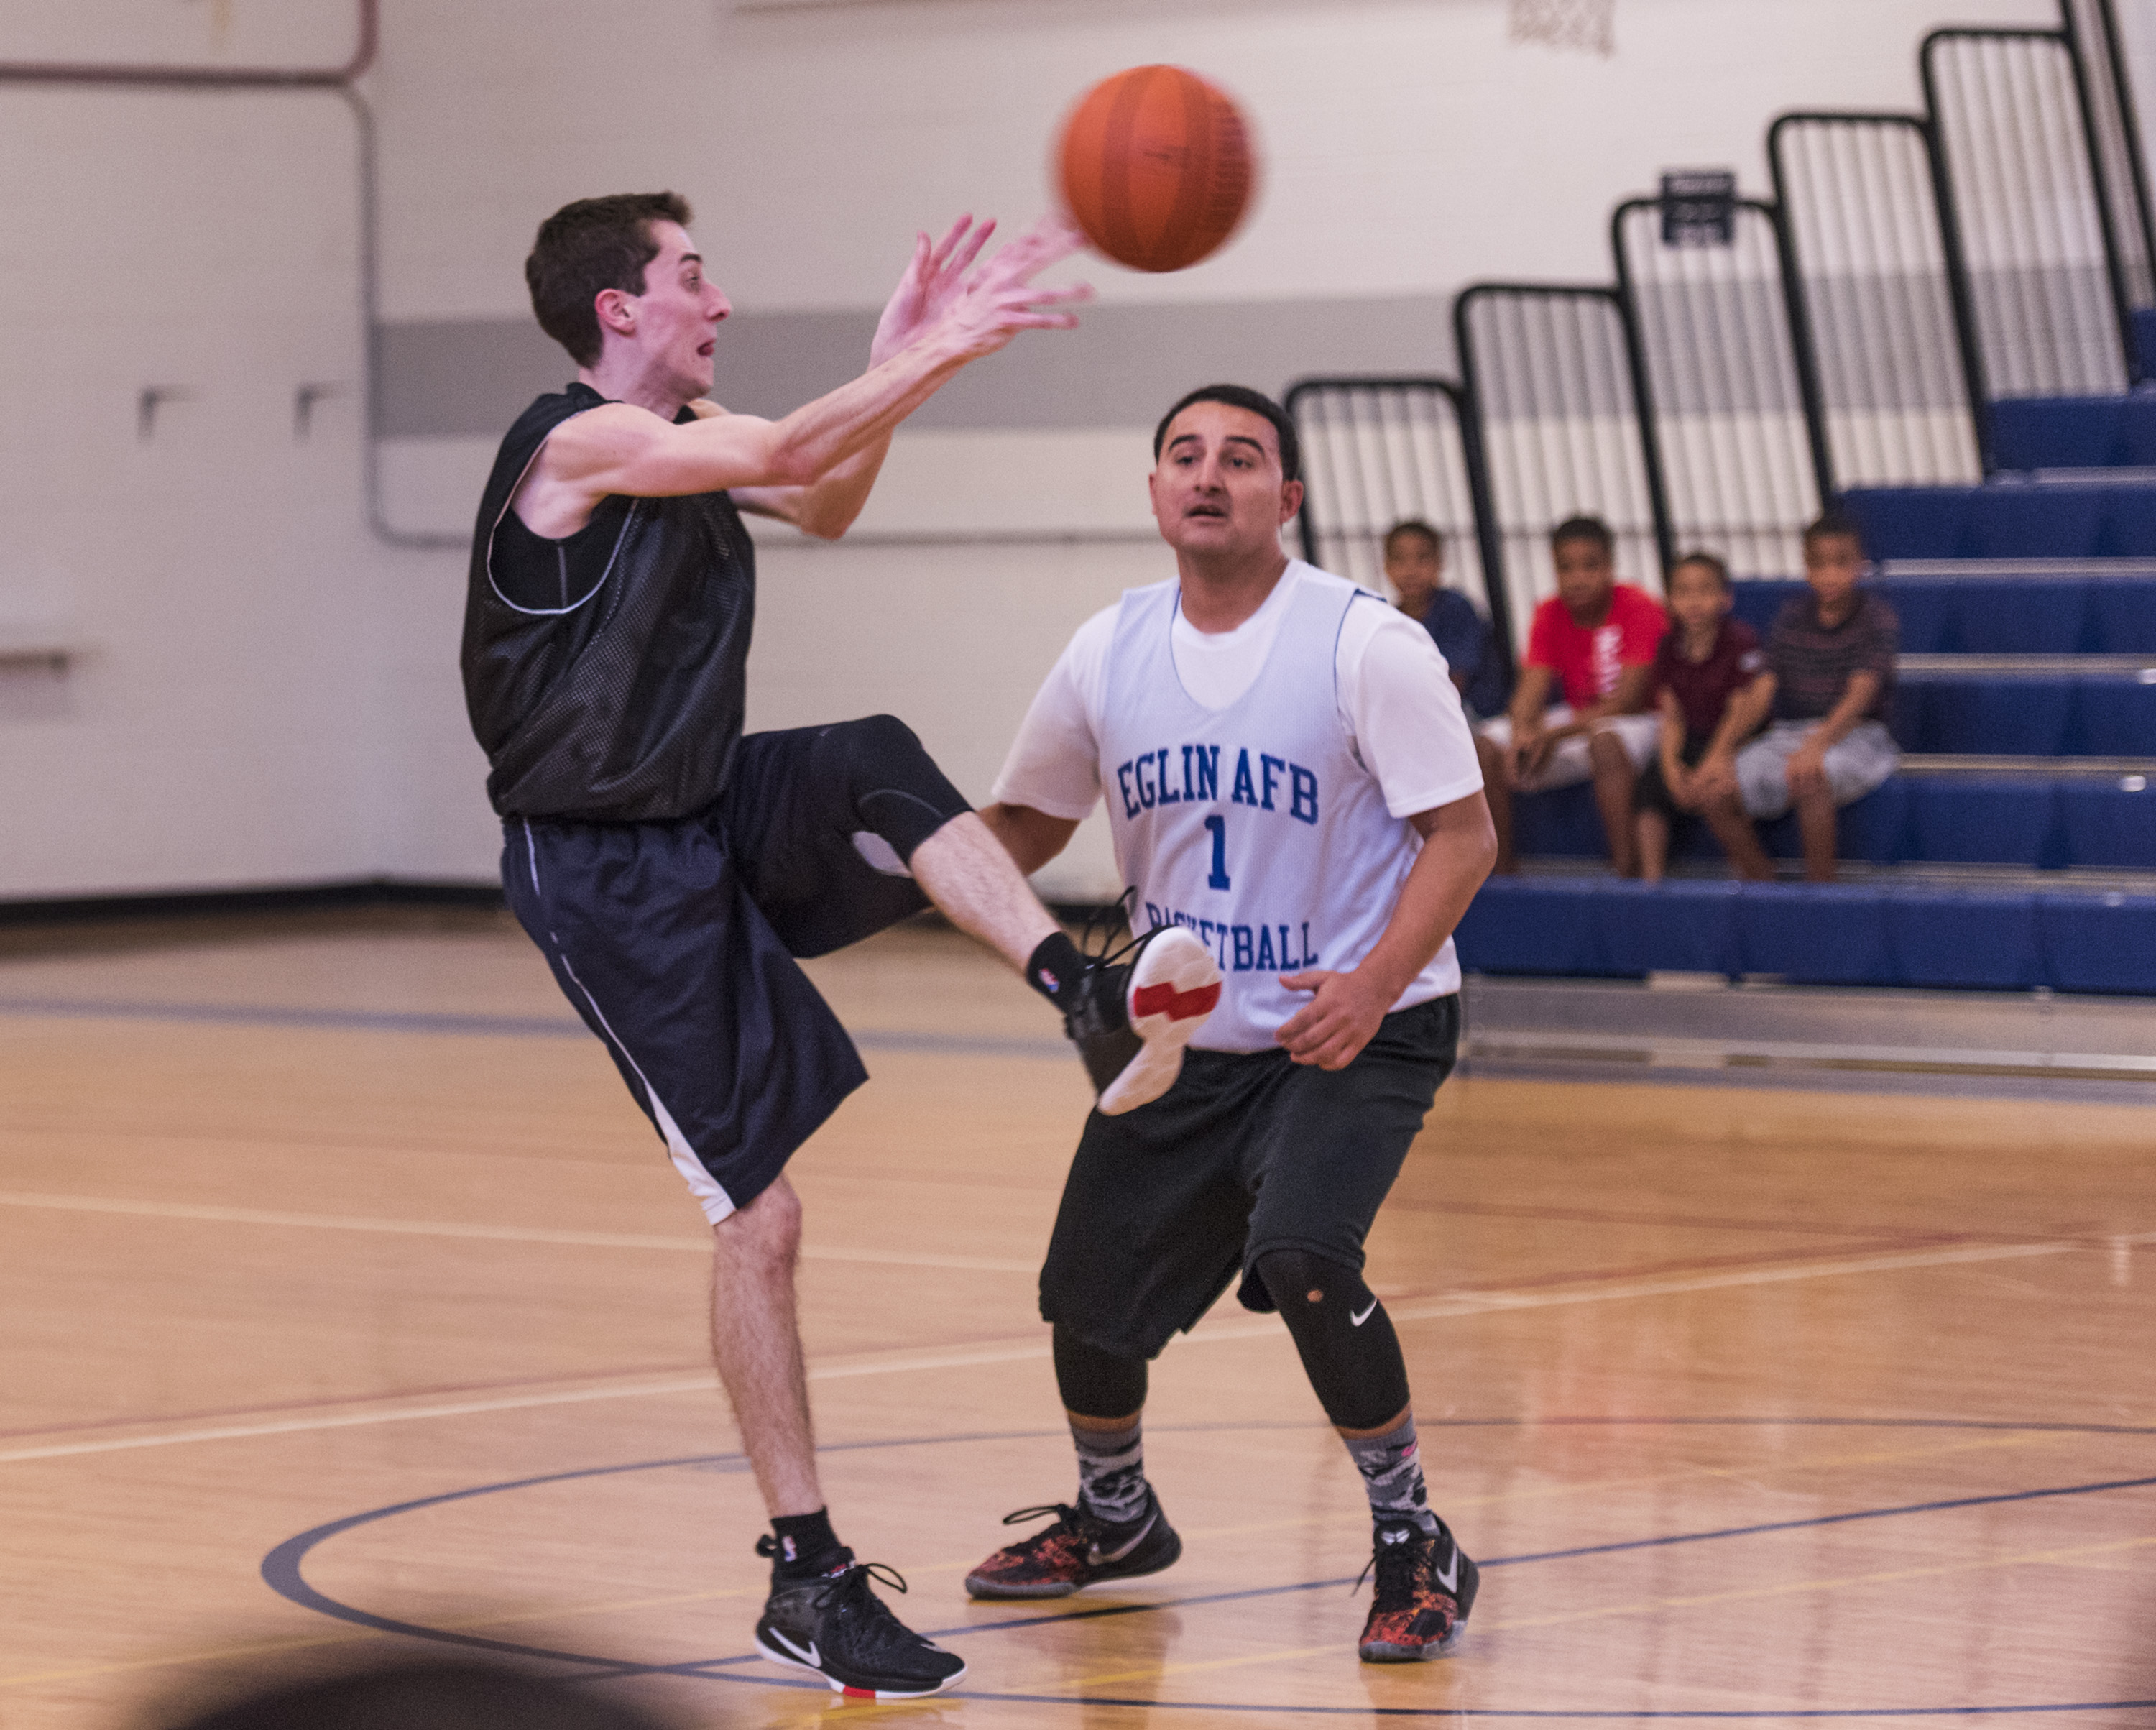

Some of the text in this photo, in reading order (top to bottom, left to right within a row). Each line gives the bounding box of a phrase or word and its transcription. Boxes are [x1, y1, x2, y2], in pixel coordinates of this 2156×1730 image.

[1118, 745, 1319, 825] EGLIN AFB
[1204, 814, 1231, 891] 1
